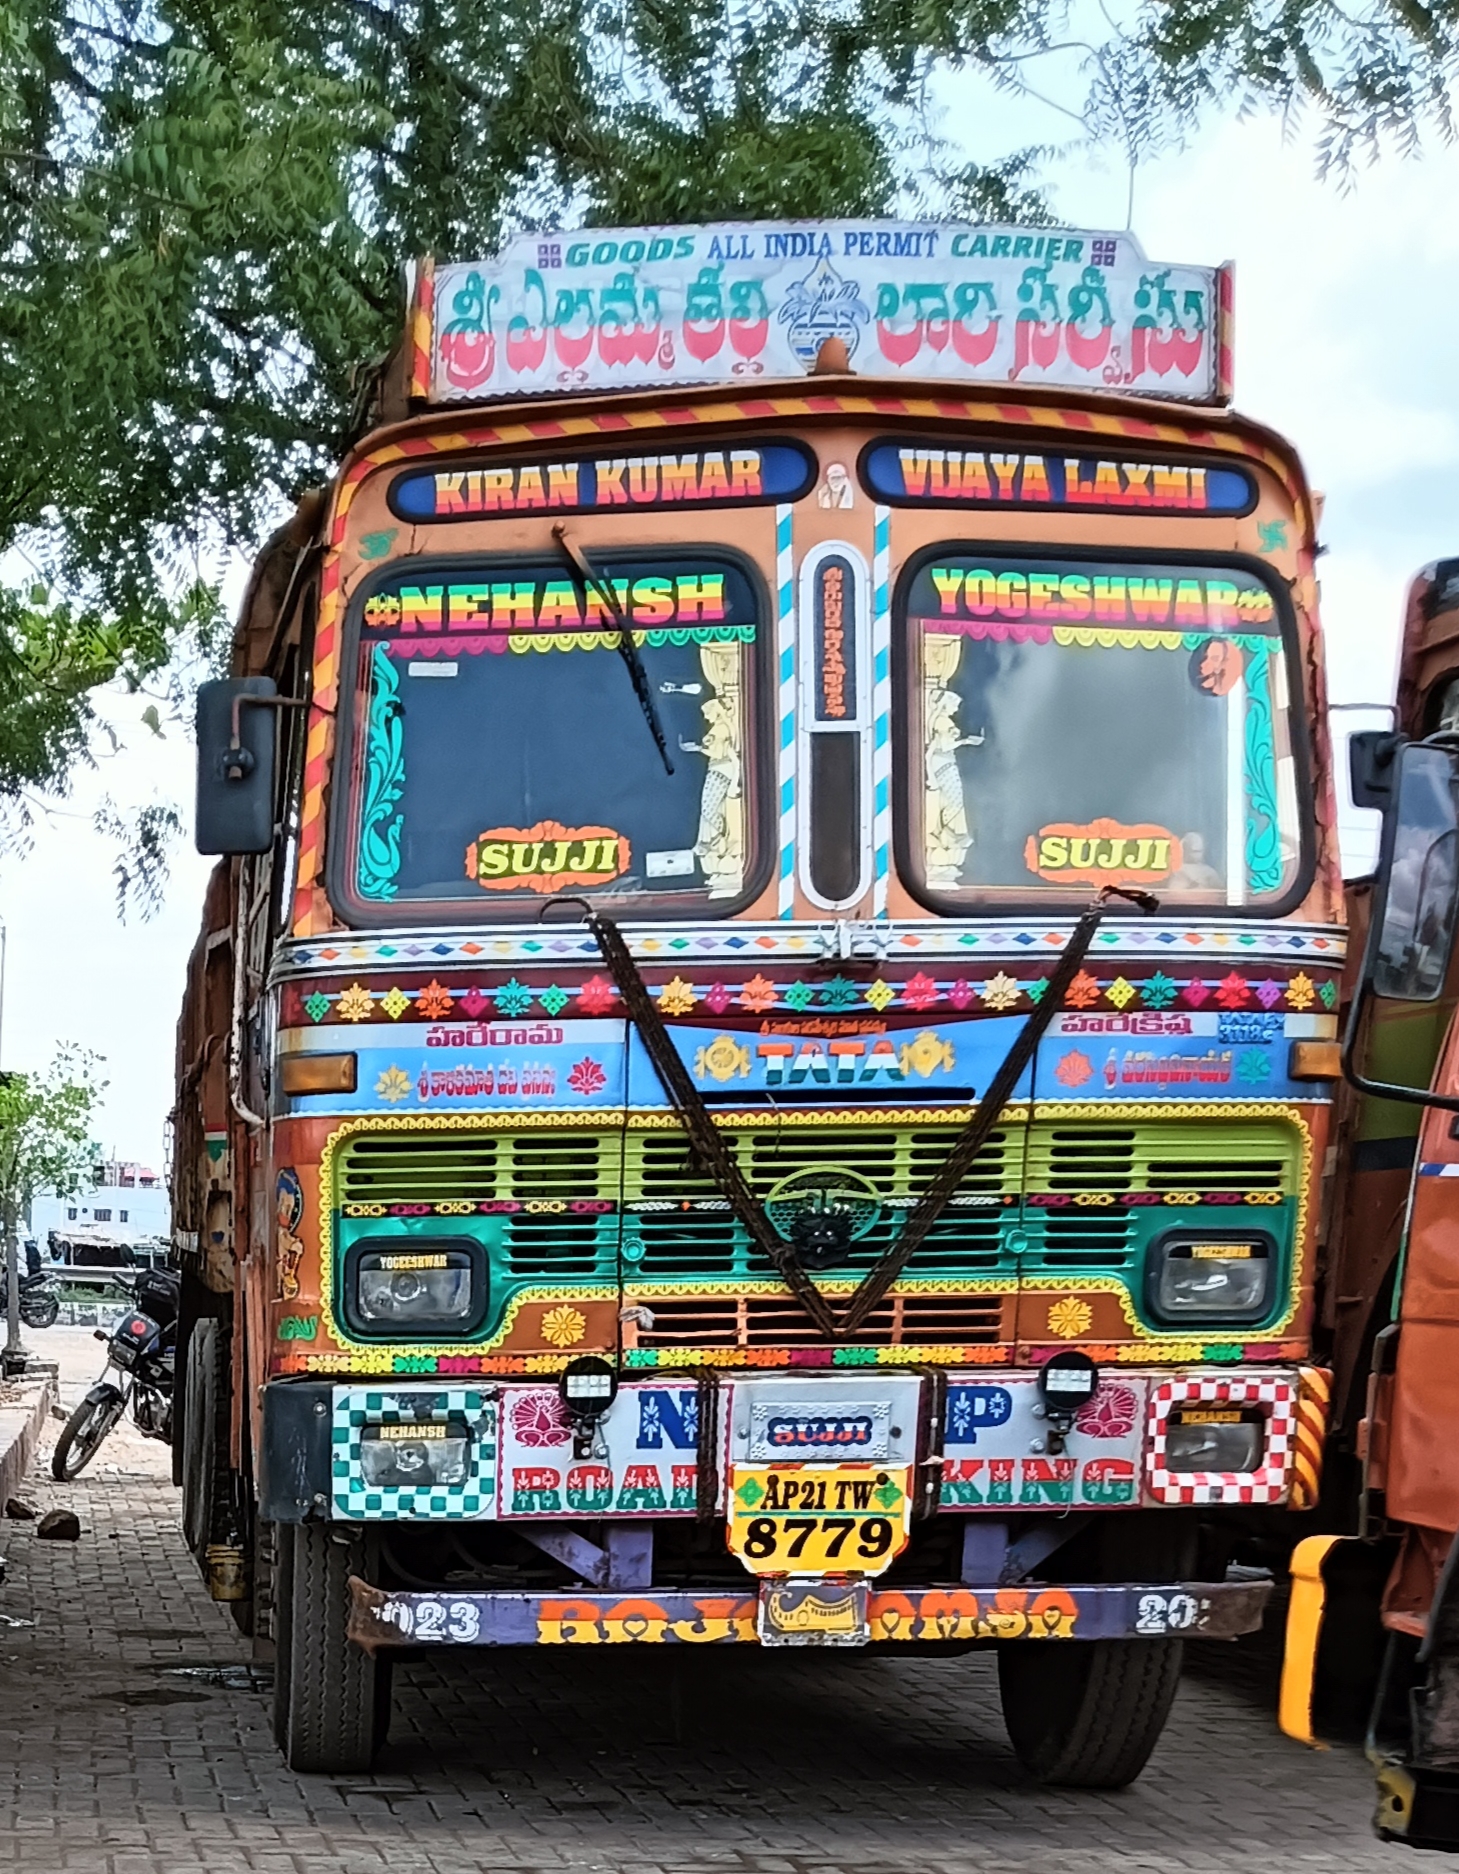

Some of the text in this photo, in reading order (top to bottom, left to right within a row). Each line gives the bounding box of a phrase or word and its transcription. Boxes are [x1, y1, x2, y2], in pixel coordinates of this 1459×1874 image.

[565, 235, 695, 268] GOODS
[707, 230, 939, 261] ALL INDIA PERMIT
[951, 233, 1084, 263] CARRIER
[440, 271, 500, 392] శ్రీ
[435, 449, 762, 515] KIRAN KUMAR
[899, 448, 1207, 510] VIJAYA LAXMI
[400, 573, 727, 633] NEHANSH
[932, 567, 1240, 627] YOGESHWAR
[478, 839, 619, 876] SUJJI
[1038, 837, 1171, 871] SUJJI
[757, 1041, 905, 1085] TATA
[380, 1426, 446, 1439] NEHANSH
[636, 1386, 1012, 1449] N P
[773, 1421, 868, 1444] SUJJI
[760, 1476, 875, 1510] AP21 TW
[941, 1458, 1134, 1504] KING
[744, 1517, 893, 1559] 8779
